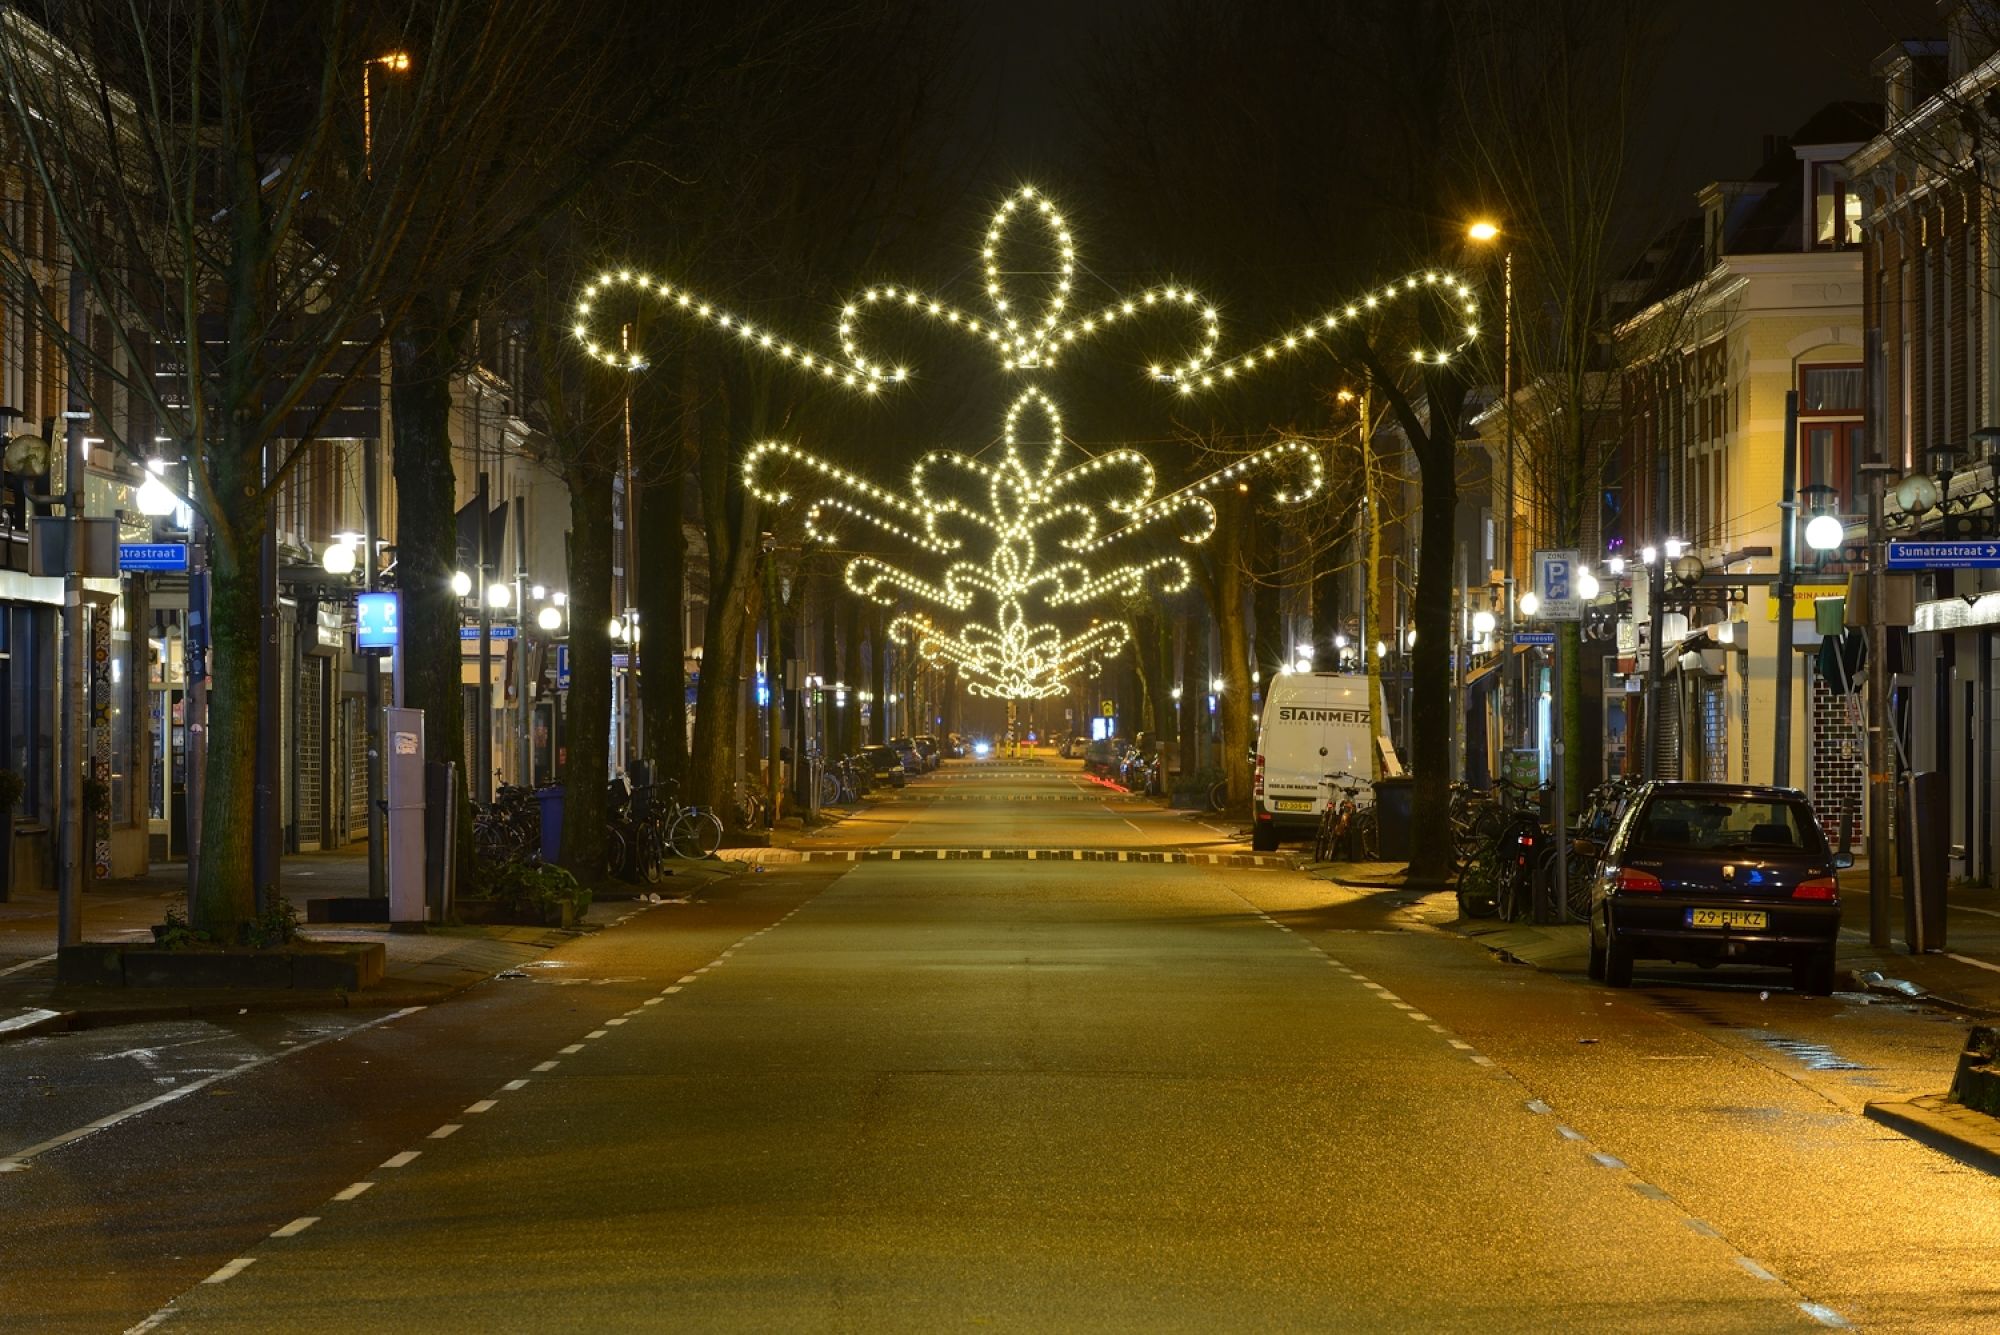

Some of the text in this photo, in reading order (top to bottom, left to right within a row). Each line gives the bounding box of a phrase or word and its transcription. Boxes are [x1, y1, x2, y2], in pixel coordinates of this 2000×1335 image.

[119, 548, 176, 558] atrastraat
[1898, 546, 1983, 557] Sumatrastraat
[1548, 562, 1565, 583] P
[464, 628, 512, 636] Bornstraat
[1279, 707, 1370, 724] STAINMETZ
